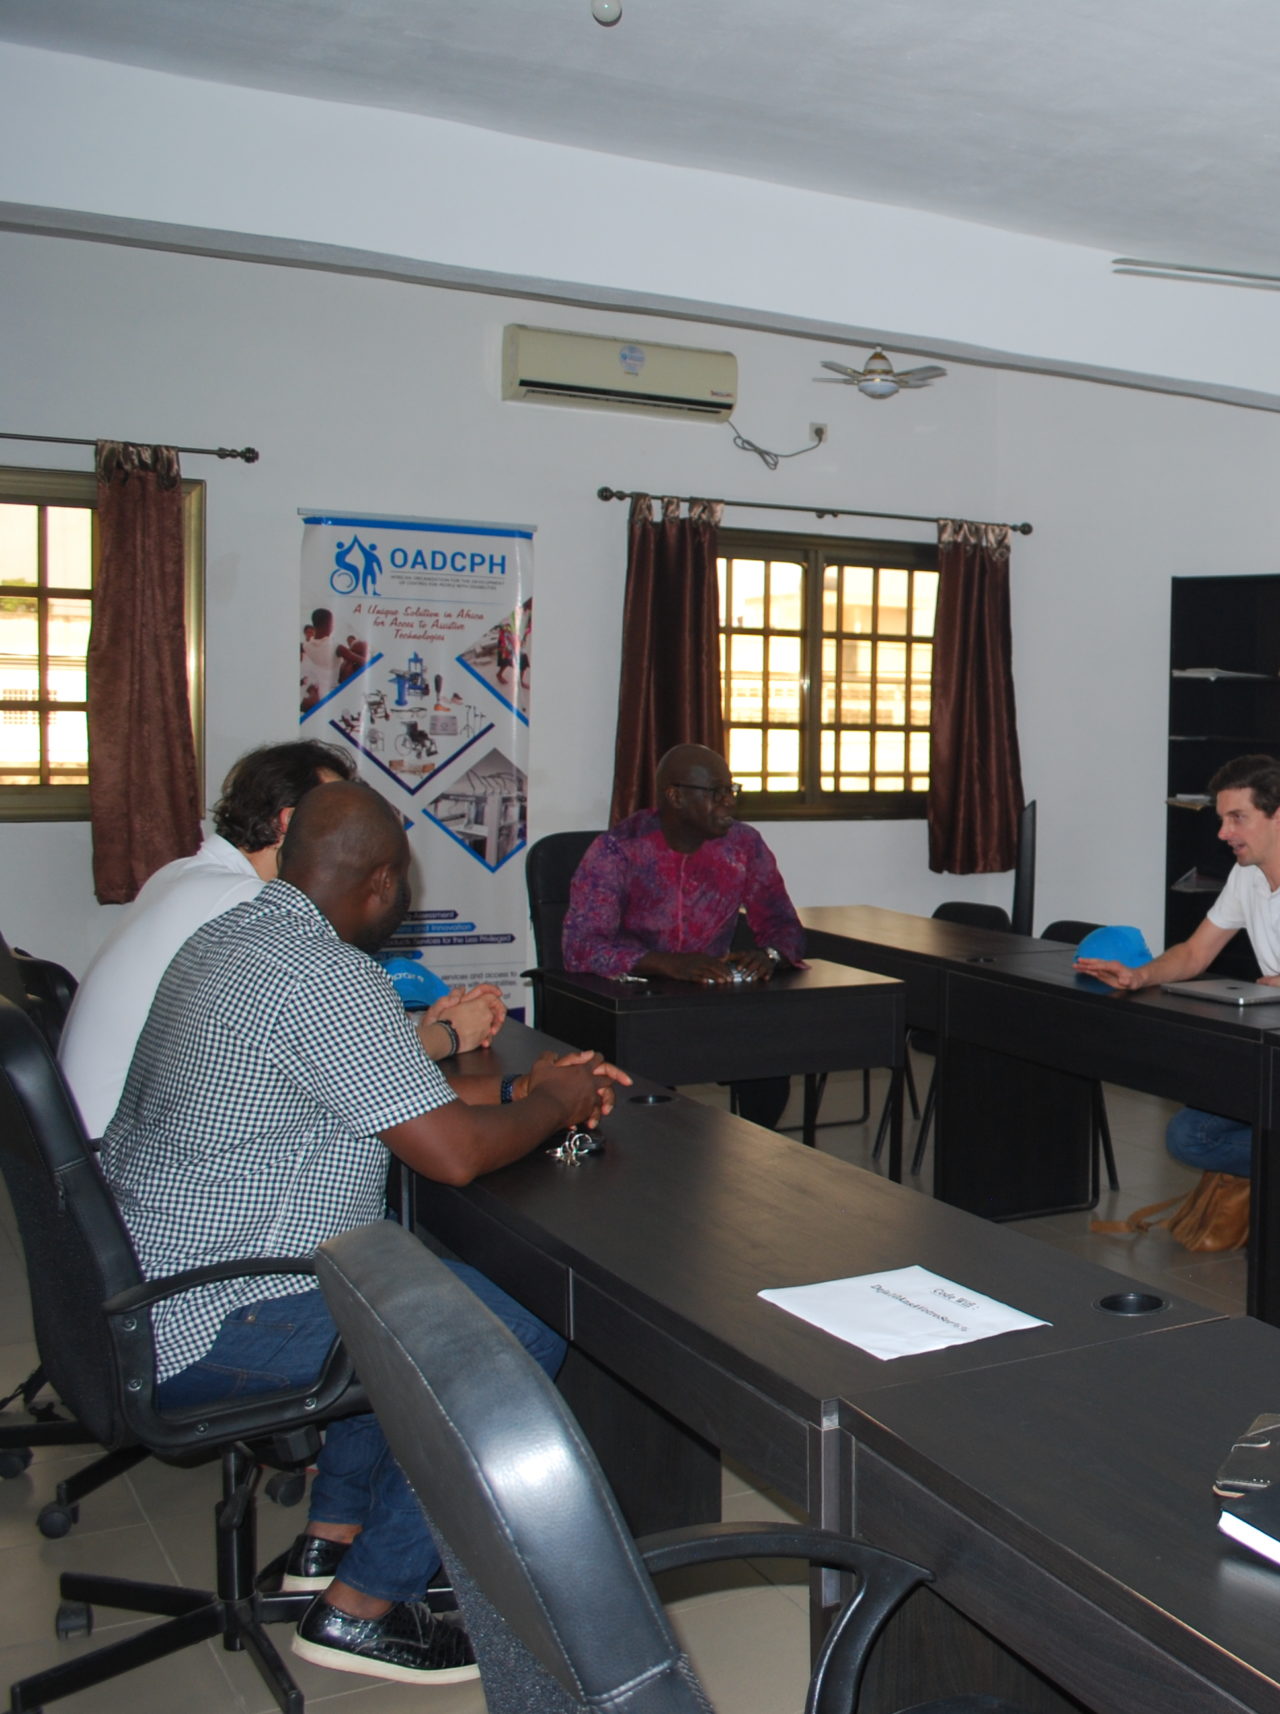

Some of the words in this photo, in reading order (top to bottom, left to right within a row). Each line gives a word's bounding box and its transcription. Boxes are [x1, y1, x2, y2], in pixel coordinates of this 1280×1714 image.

[390, 547, 507, 575] OADCPH
[353, 603, 362, 614] A
[367, 603, 399, 618] Unique
[403, 605, 440, 618] Solution
[456, 608, 485, 620] Africa
[394, 628, 445, 643] Technologies
